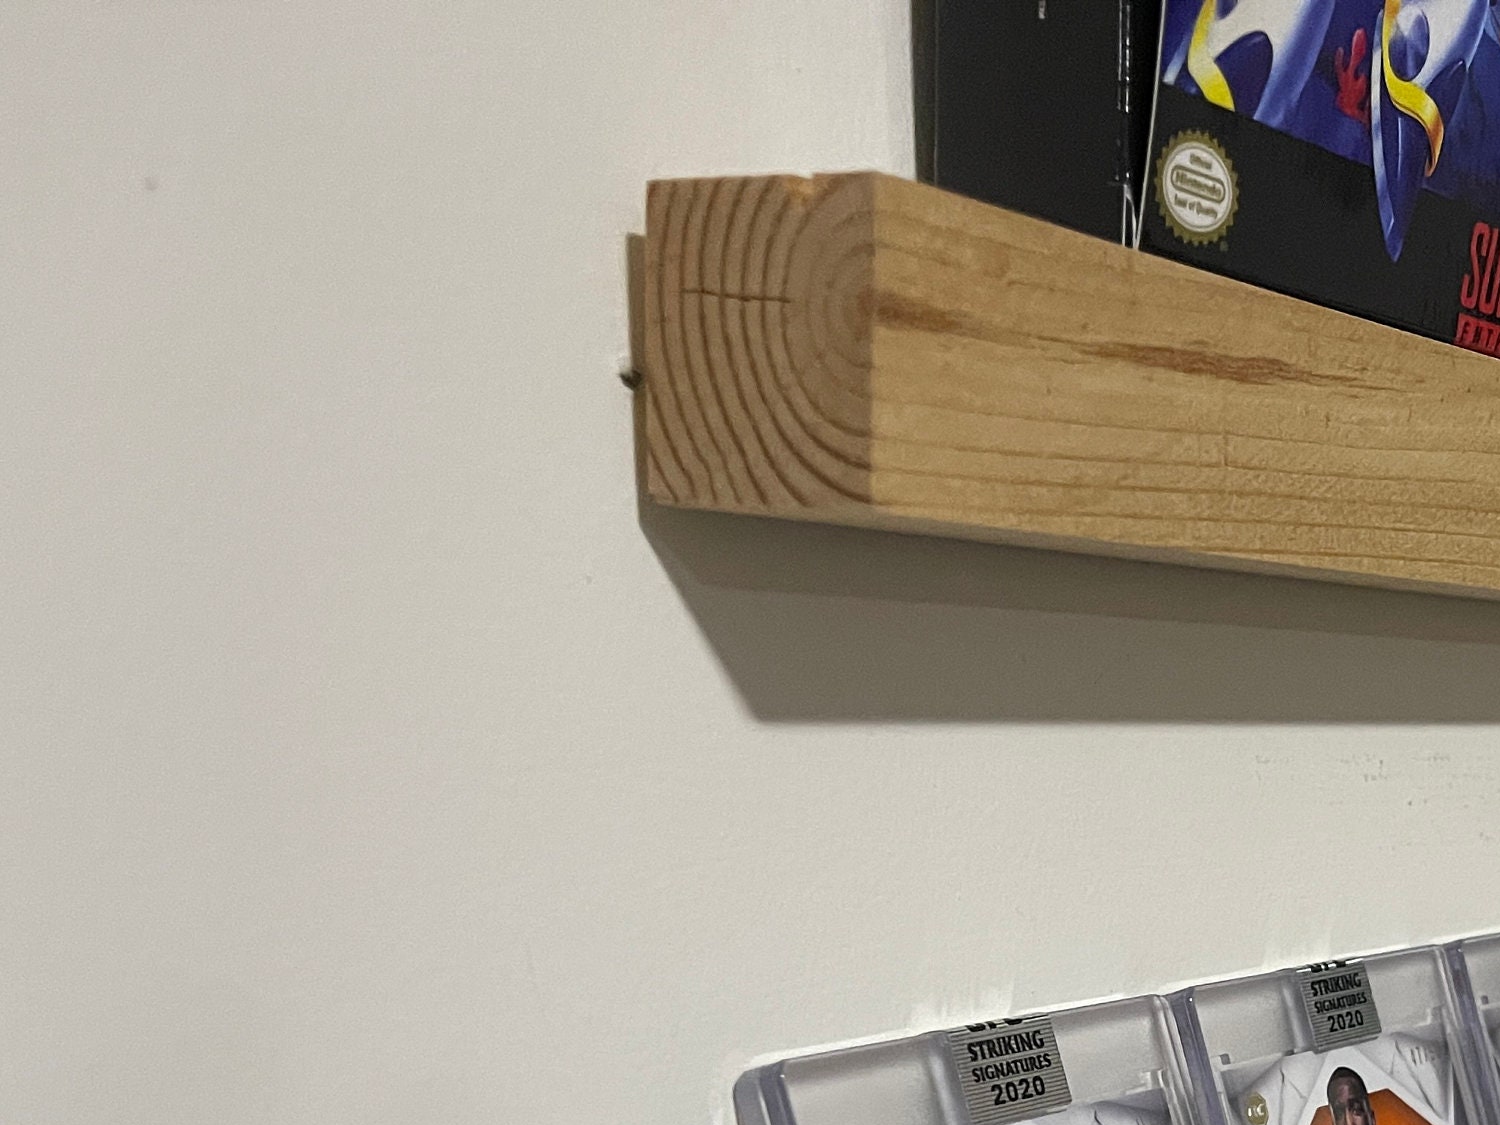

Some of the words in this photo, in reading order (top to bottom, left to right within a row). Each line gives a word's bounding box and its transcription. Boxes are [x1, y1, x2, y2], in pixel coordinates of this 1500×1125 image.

[1310, 972, 1362, 997] STRIKING
[1314, 992, 1367, 1014] SIGNATURES
[1327, 1009, 1364, 1033] 2020
[967, 1029, 1045, 1062] STRIKING
[971, 1053, 1052, 1083] SIGNATURES
[990, 1075, 1046, 1106] 2020
